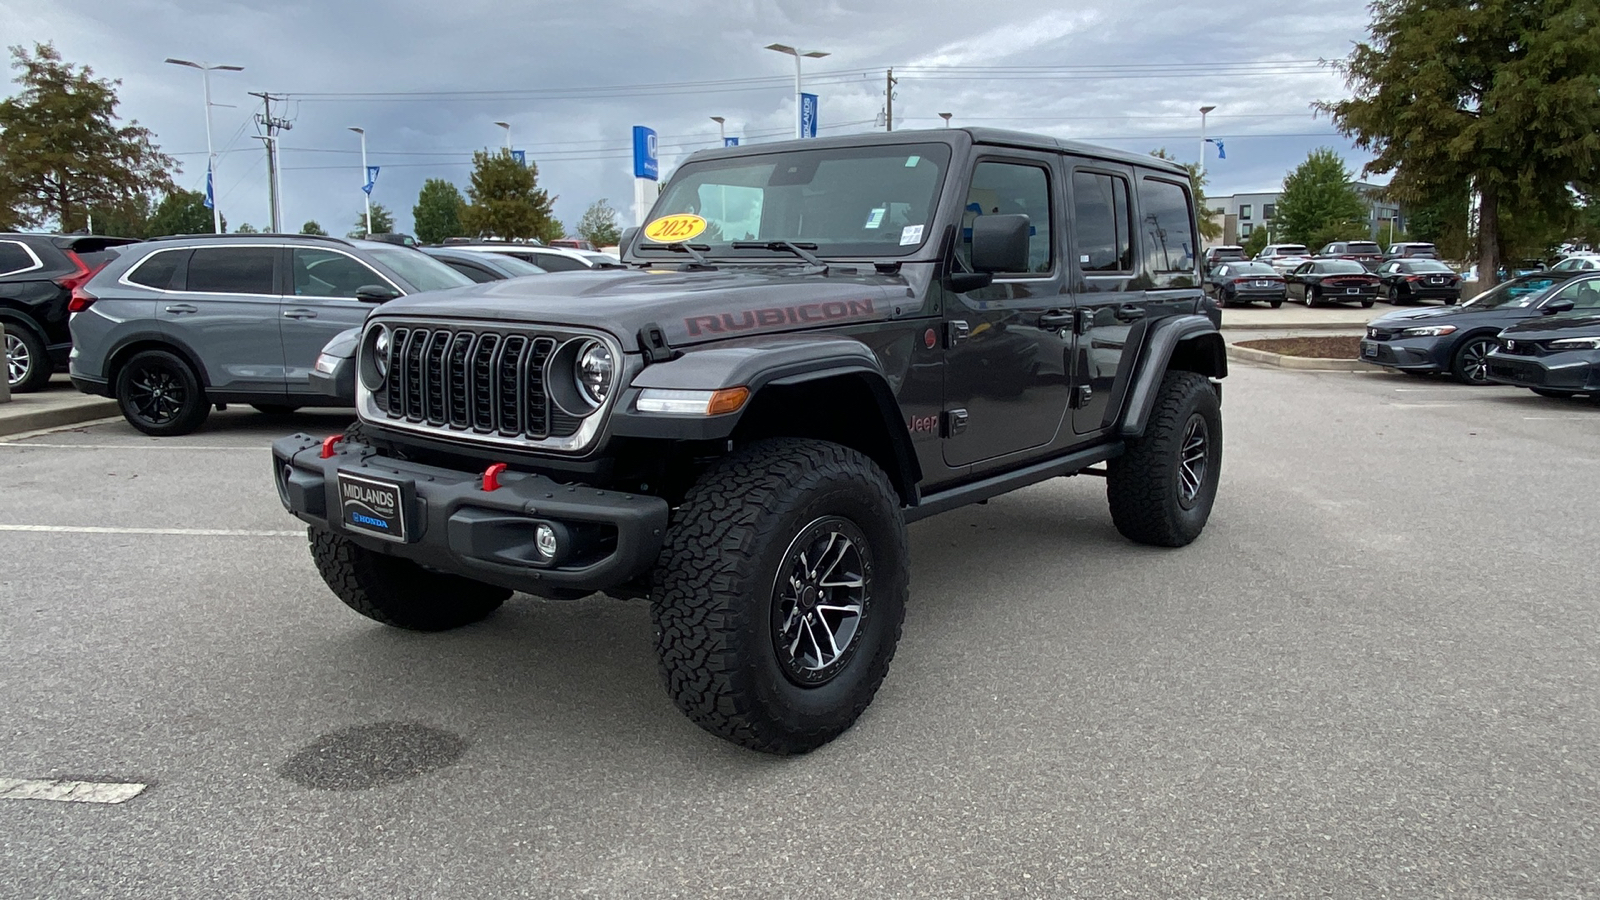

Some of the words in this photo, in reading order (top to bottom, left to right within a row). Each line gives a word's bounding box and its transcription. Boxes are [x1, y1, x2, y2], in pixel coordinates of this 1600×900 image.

[652, 219, 699, 236] 2025
[684, 299, 874, 336] RUBICON
[907, 415, 937, 434] Jeep
[343, 483, 394, 507] MIDLANDS
[359, 515, 388, 528] HONDA
